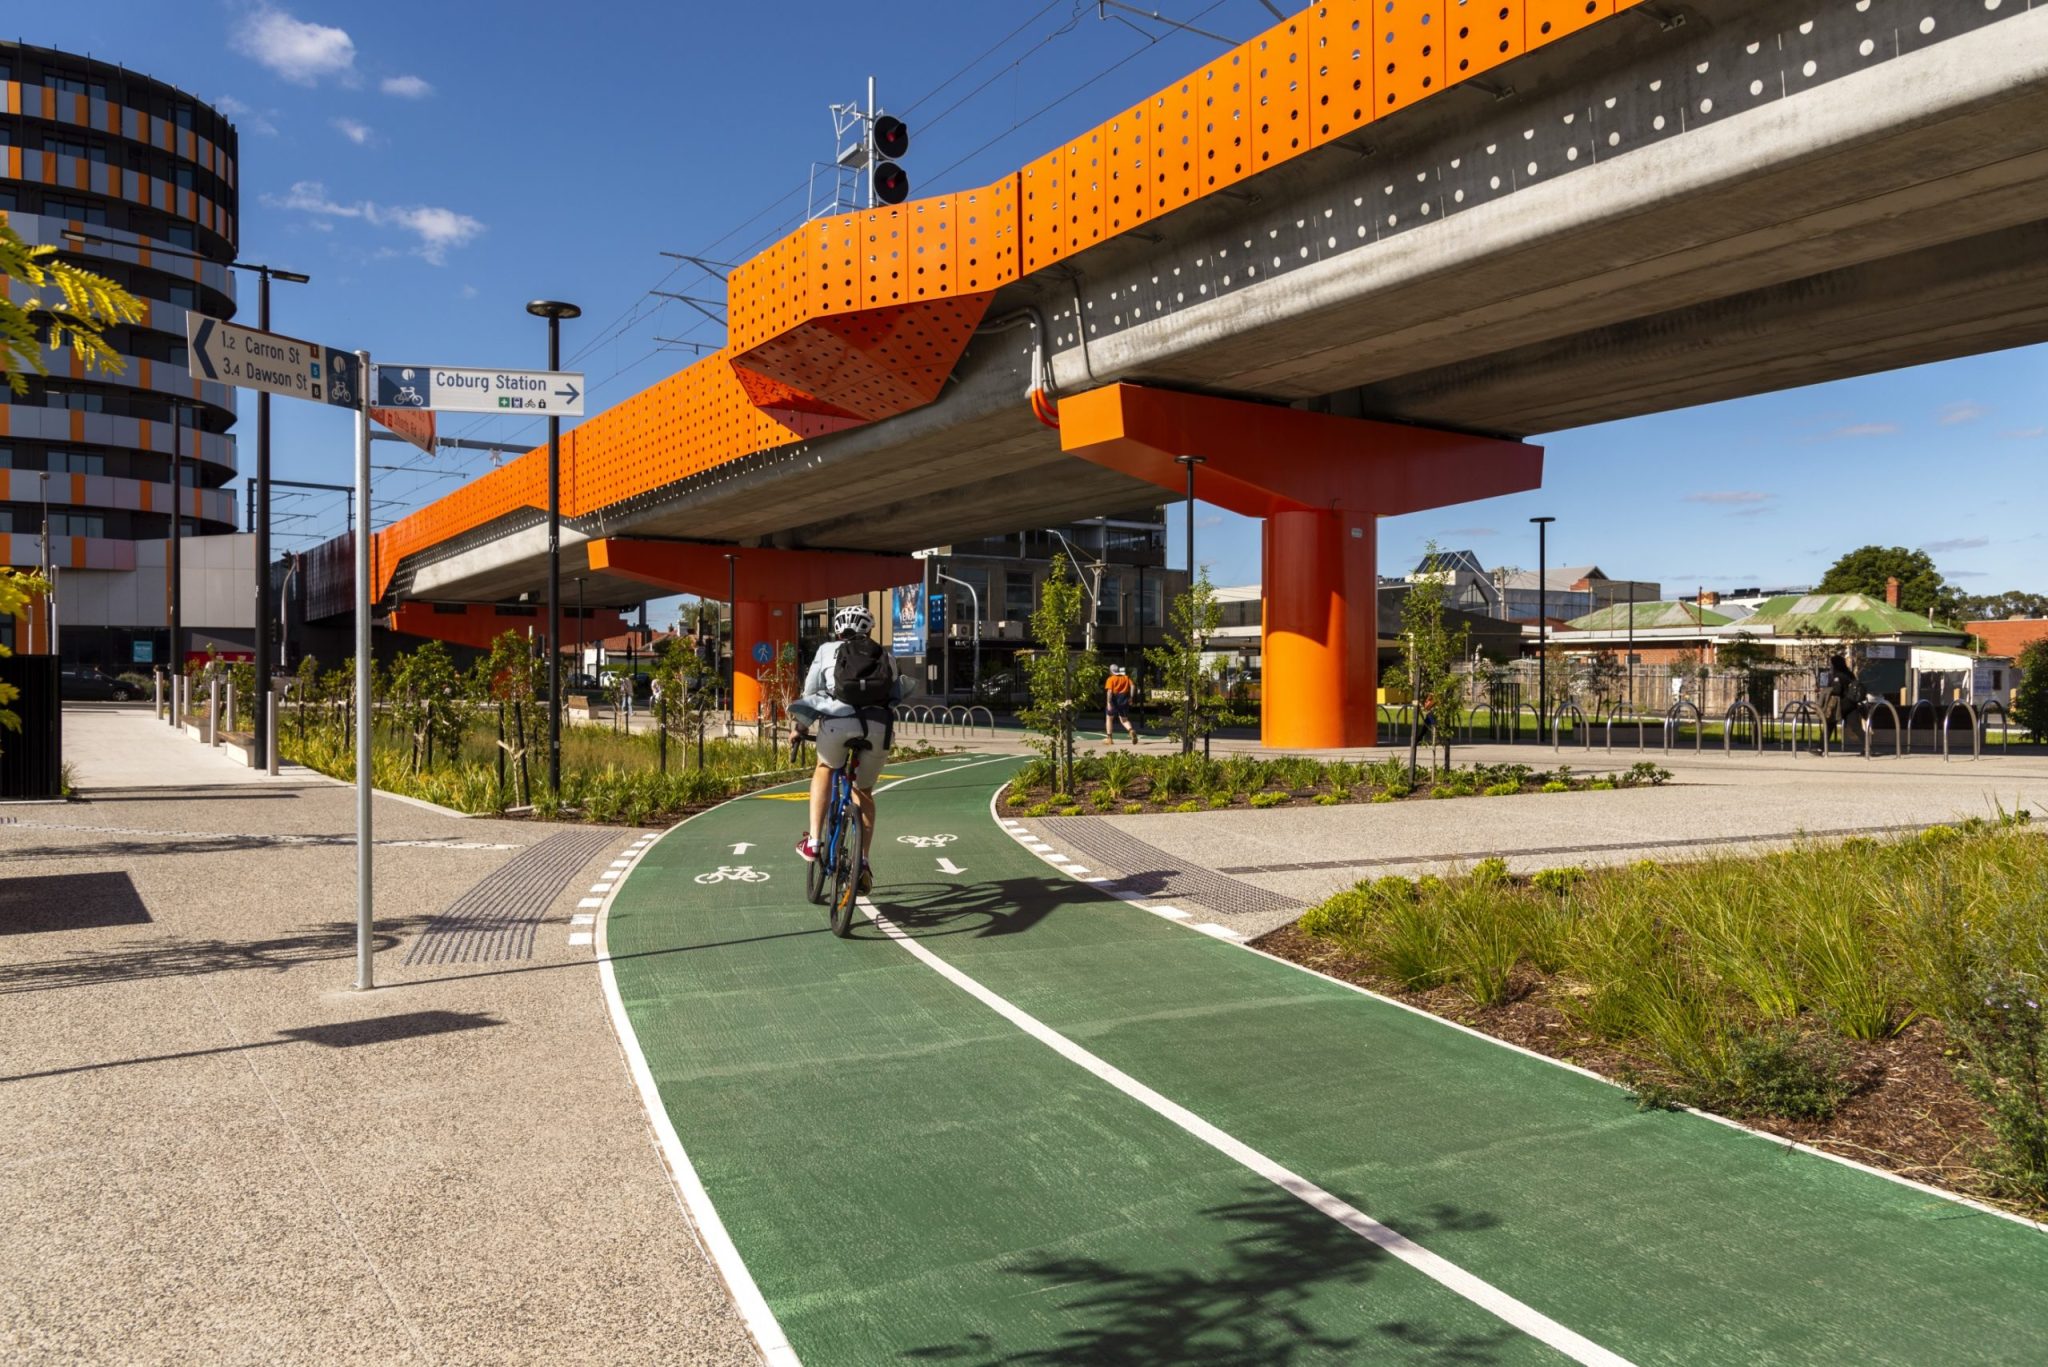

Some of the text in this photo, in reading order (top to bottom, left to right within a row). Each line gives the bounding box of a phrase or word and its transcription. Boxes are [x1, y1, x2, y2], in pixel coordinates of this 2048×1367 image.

[222, 331, 301, 365] 1.2 Carron St
[223, 356, 308, 391] 3.4 Dawson St
[436, 371, 547, 393] Coburg Station
